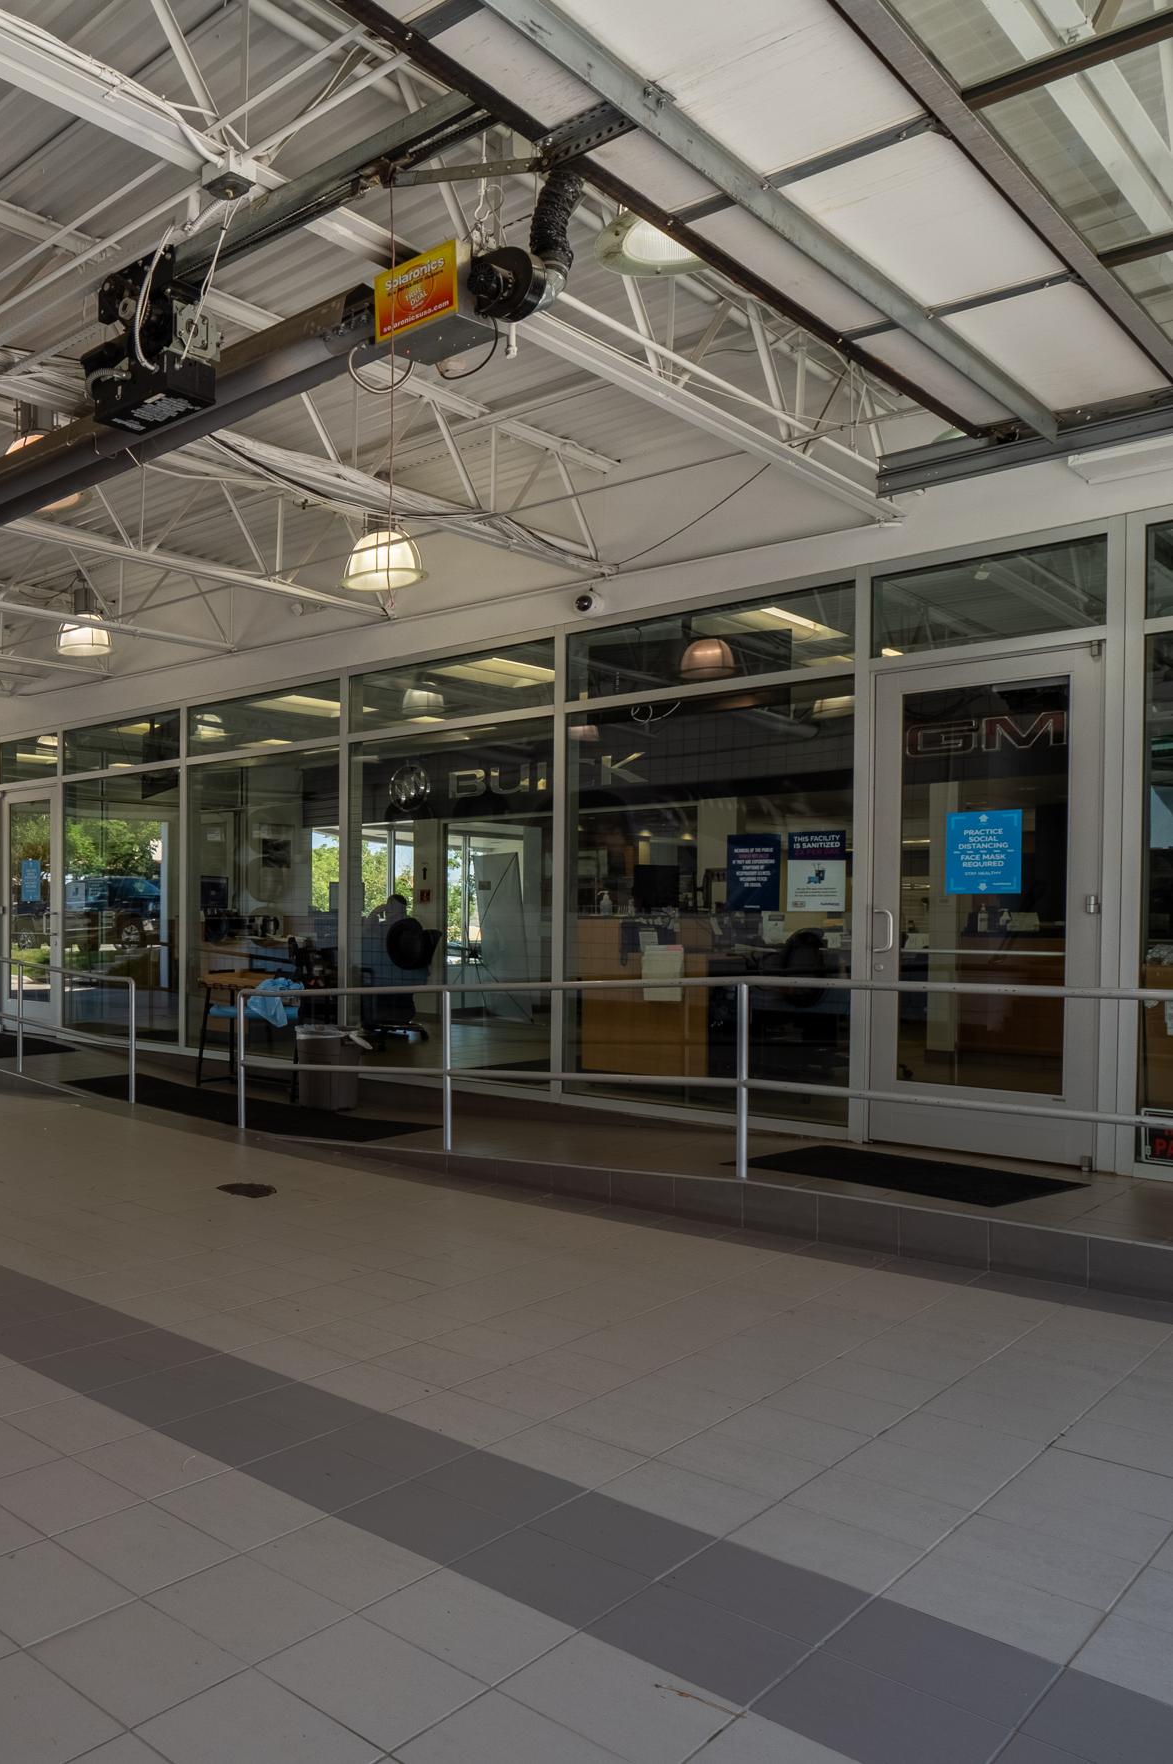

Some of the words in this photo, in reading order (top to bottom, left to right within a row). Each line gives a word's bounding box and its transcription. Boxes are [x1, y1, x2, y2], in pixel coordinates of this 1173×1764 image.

[384, 257, 445, 290] Solaronics
[383, 300, 449, 333] soaronicsusa.com
[906, 710, 1067, 758] GM
[963, 828, 1004, 836] PRACTICE
[810, 834, 840, 842] FACILITY
[968, 835, 999, 843] SOCIAL
[958, 842, 1009, 850] DISTANCING
[982, 853, 1006, 861] MASK
[962, 860, 1004, 868] REQUIRED
